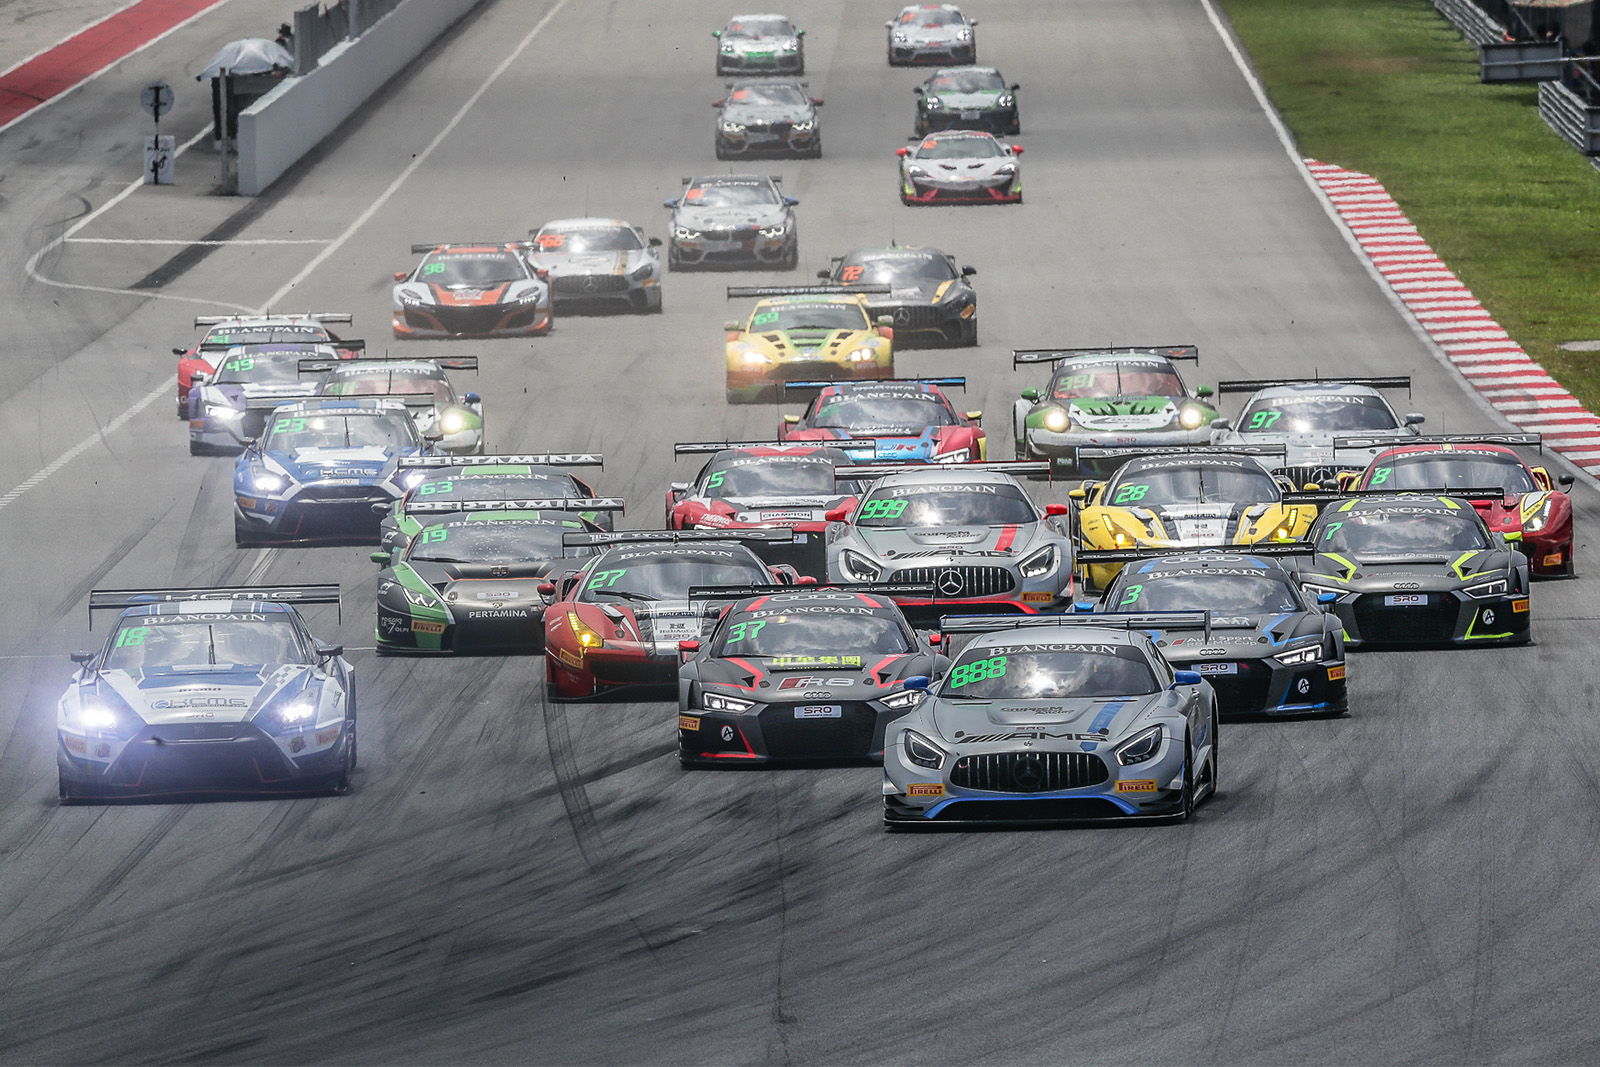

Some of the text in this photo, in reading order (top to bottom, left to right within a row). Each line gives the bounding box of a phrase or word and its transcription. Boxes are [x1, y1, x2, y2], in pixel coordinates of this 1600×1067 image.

[424, 263, 445, 275] 98
[218, 326, 314, 334] BLANCPAIN
[1071, 361, 1159, 370] BLANCPAIN
[1059, 373, 1096, 391] 991
[829, 392, 936, 402] BLANCPAIN
[1272, 396, 1364, 405] BLANCPAIN
[294, 410, 387, 418] BLANCPAIN
[1248, 411, 1282, 429] 97
[273, 418, 306, 434] 23
[1397, 450, 1499, 459] BLANCPAIN
[732, 457, 832, 466] BLANCPAIN
[1140, 460, 1244, 469] BLANCPAIN
[447, 473, 549, 481] BLANCPAIN
[707, 470, 727, 489] 5
[1371, 468, 1392, 485] 8
[420, 481, 453, 495] 63
[891, 486, 997, 498] BLANCPAIN
[1115, 485, 1149, 504] 28
[859, 499, 909, 520] 999
[1346, 507, 1460, 518] BLANCPAIN
[449, 518, 556, 527] BLANCPAIN
[421, 529, 447, 544] 19
[1325, 522, 1344, 541] 7
[619, 550, 733, 560] BLANCPAIN
[934, 550, 1013, 558] AMG
[587, 569, 627, 590] 27
[1146, 568, 1267, 581] BLANCPAIN
[1121, 585, 1143, 606] 3
[469, 610, 528, 618] PERTAMINA
[751, 606, 875, 618] BLANCPAIN
[142, 613, 267, 626] BLANCPAIN
[413, 621, 442, 632] PIRELLI
[727, 620, 767, 644] 37
[116, 627, 148, 648] 18
[989, 644, 1118, 657] BLANCPAIN
[950, 656, 1007, 689] 888
[804, 677, 855, 687] R8
[169, 697, 246, 707] KCMG
[803, 706, 833, 714] SRO
[1003, 732, 1108, 742] AMG
[910, 786, 942, 795] PIRELLI
[1119, 781, 1154, 791] PIRELLI
